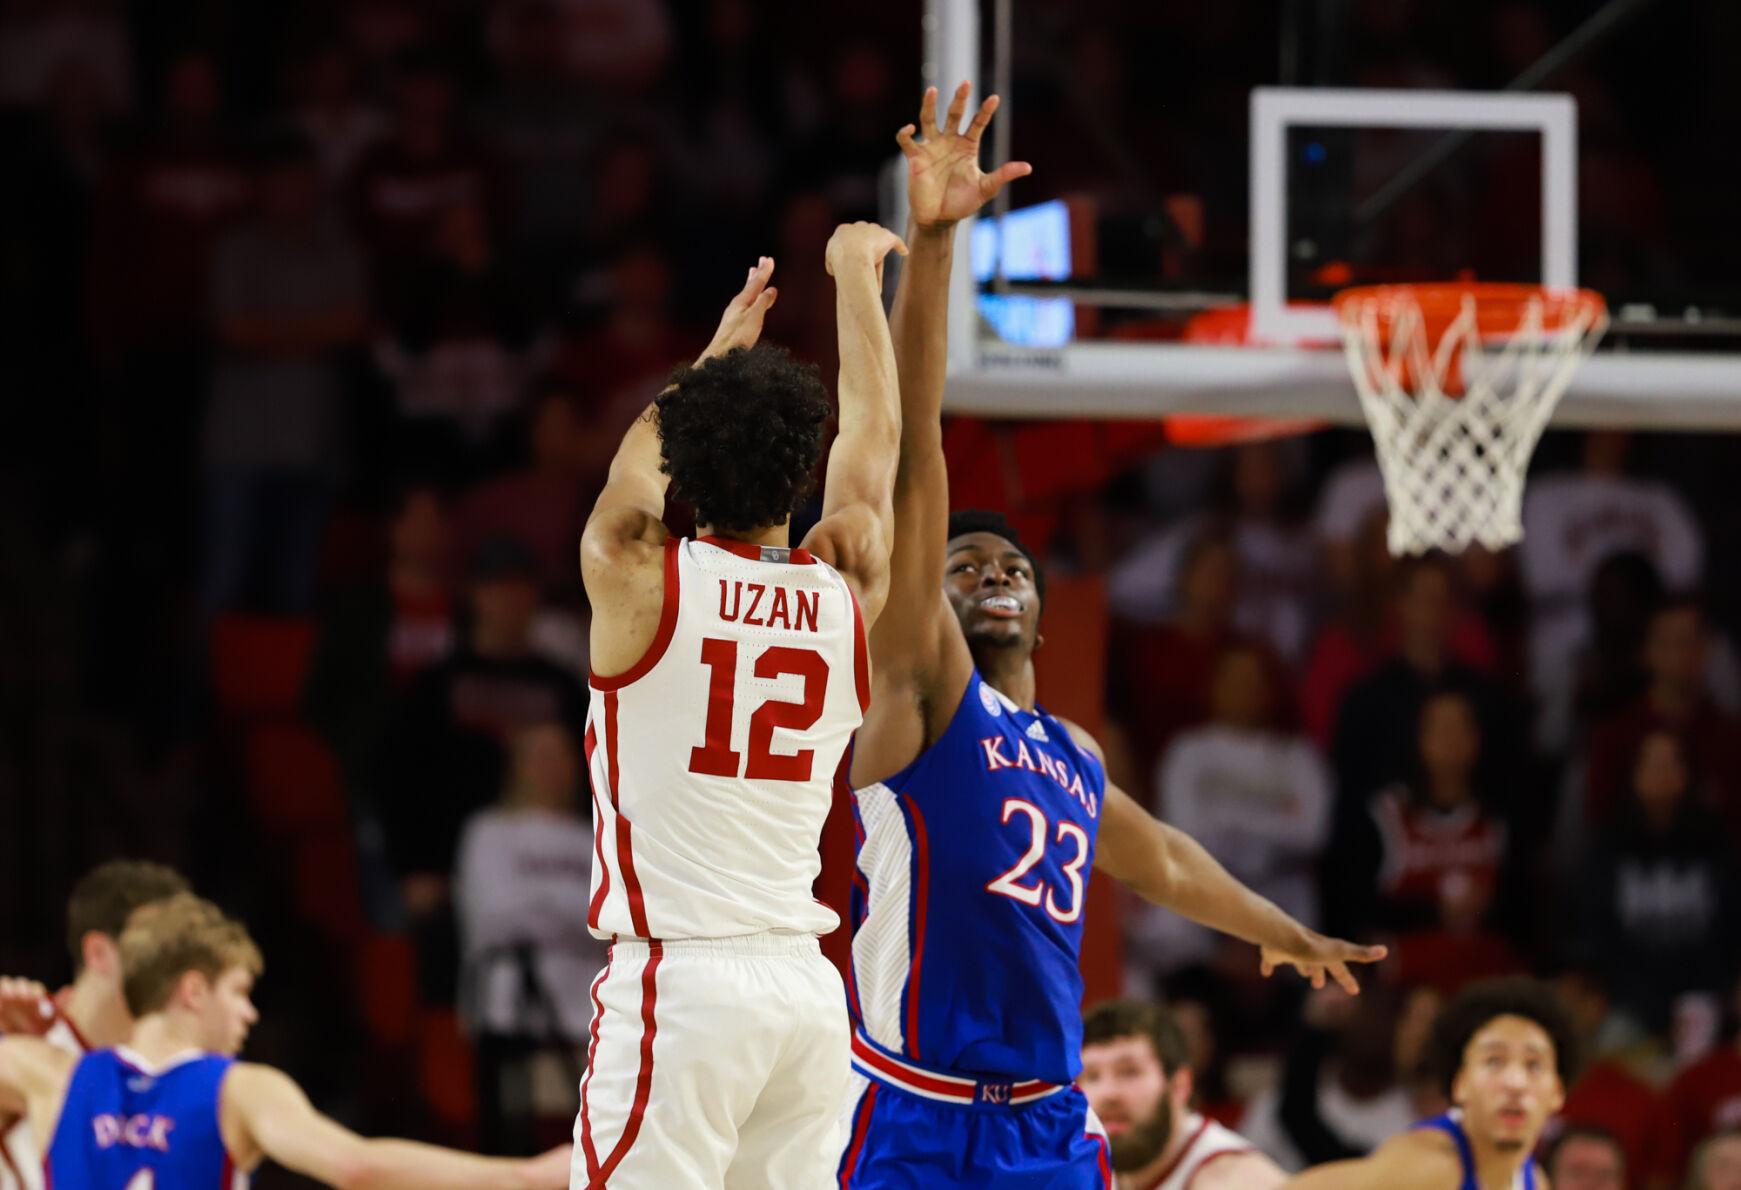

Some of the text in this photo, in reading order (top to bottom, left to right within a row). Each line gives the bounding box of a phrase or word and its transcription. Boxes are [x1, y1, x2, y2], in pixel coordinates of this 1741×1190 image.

[718, 578, 820, 633] UZAN
[688, 637, 830, 781] 12
[979, 735, 1097, 819] KANSAS
[984, 796, 1090, 923] 23
[982, 1084, 1008, 1103] KU
